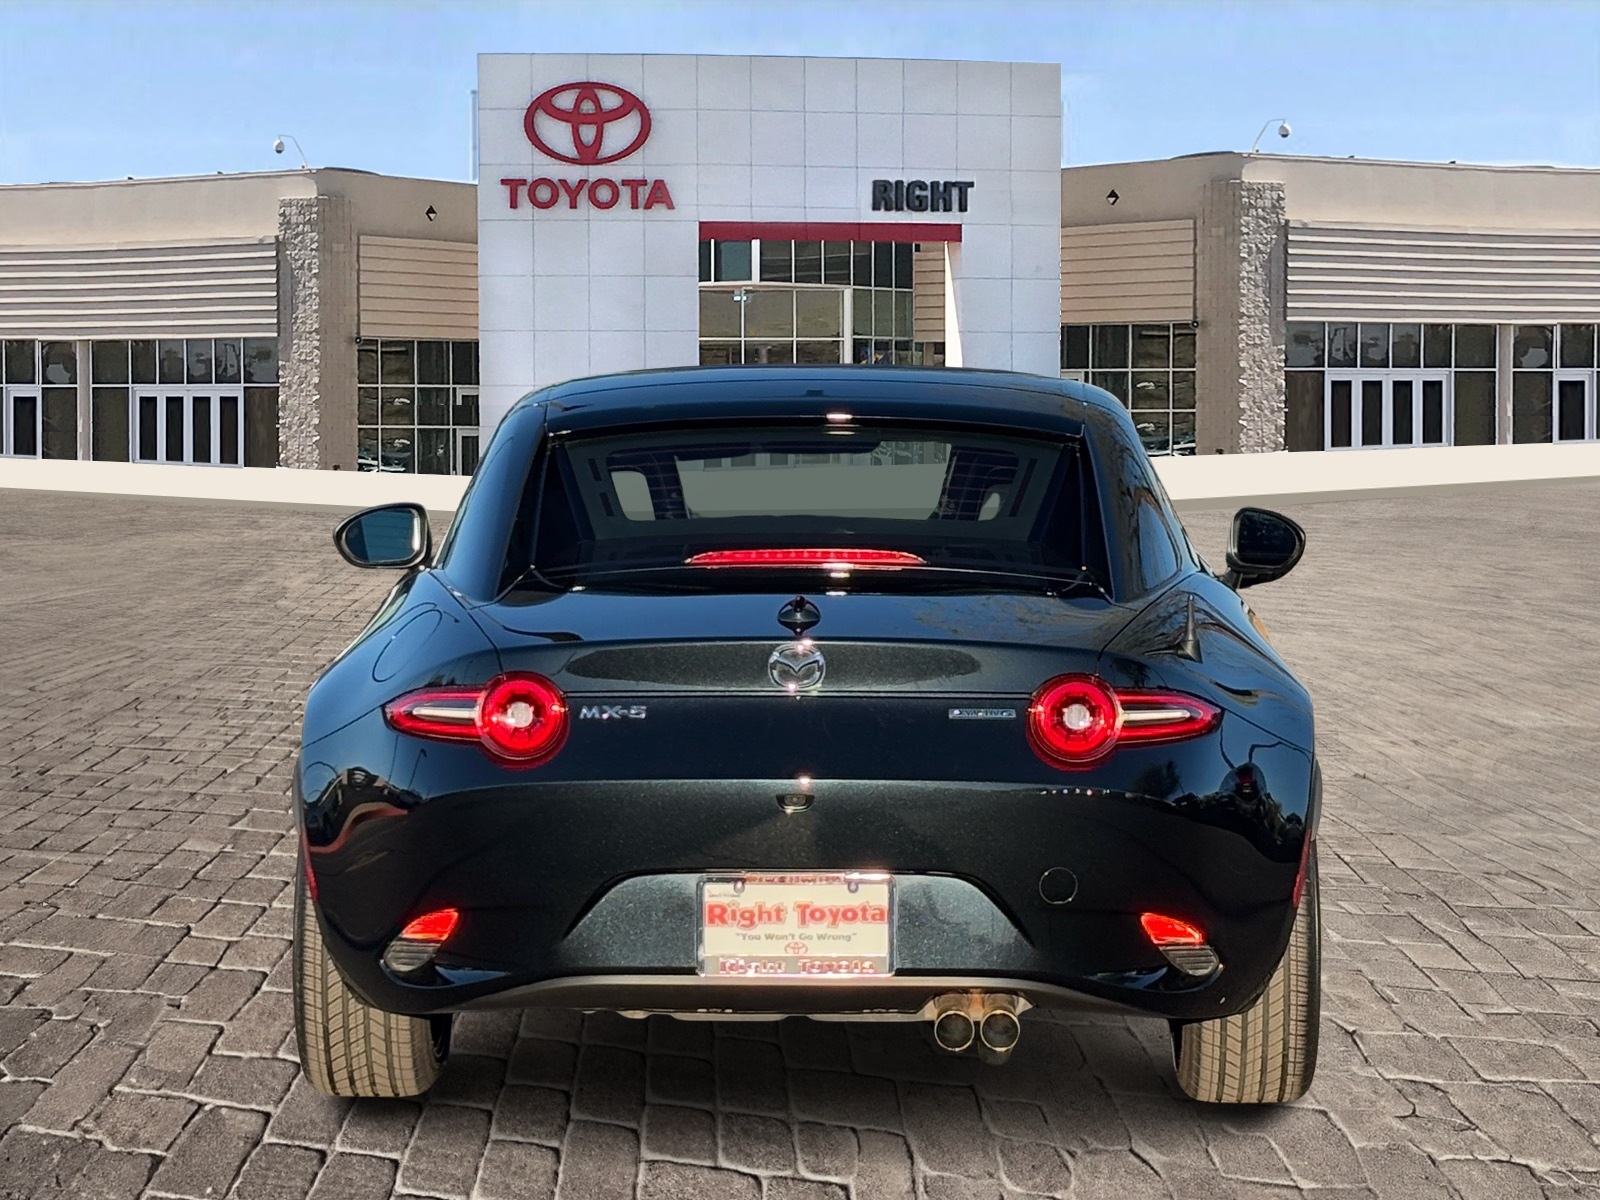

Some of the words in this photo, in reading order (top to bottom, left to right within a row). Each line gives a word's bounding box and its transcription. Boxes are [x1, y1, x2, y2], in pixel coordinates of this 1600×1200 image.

[500, 178, 676, 210] TOYOTA
[871, 179, 975, 213] RIGHT
[579, 704, 648, 720] MX-5
[705, 901, 787, 930] Right
[793, 901, 888, 928] Toyota
[764, 932, 796, 941] Won't
[798, 932, 814, 941] Go
